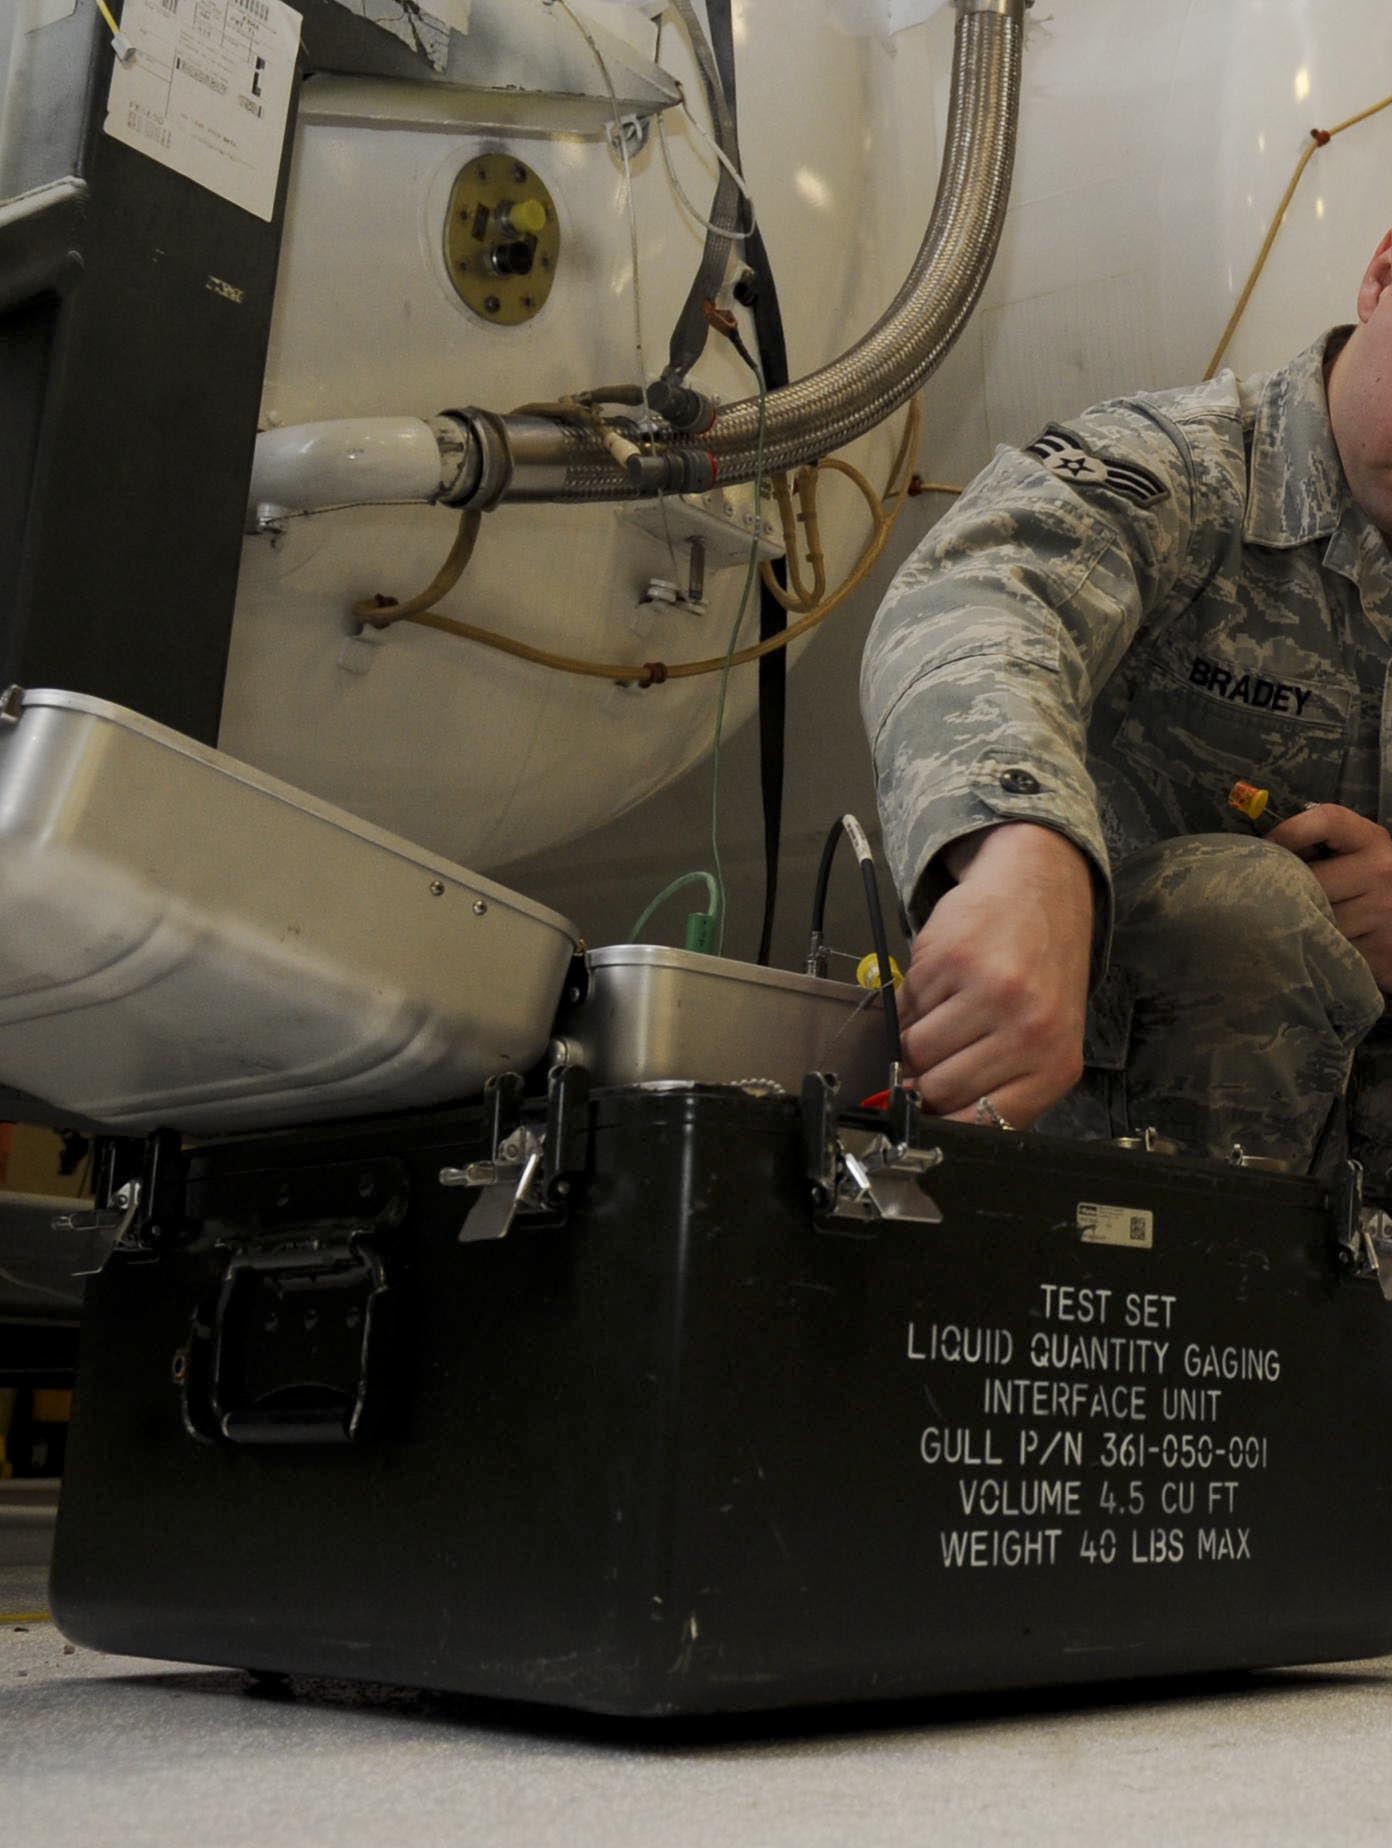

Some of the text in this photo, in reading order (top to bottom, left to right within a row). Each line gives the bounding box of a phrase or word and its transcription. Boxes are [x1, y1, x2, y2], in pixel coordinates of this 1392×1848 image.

[1189, 657, 1312, 716] BRADEY
[1041, 1284, 1176, 1328] TEST SET
[908, 1323, 1280, 1381] LIQUID QUANTITY GAGING
[985, 1379, 1221, 1421] INTERFACE UNIT
[921, 1427, 1266, 1468] GULL P/N 361-050-001
[960, 1479, 1238, 1515] VOLUME 4.5 CU FT
[941, 1528, 1250, 1567] WEIGHT 40 LBS MAX
